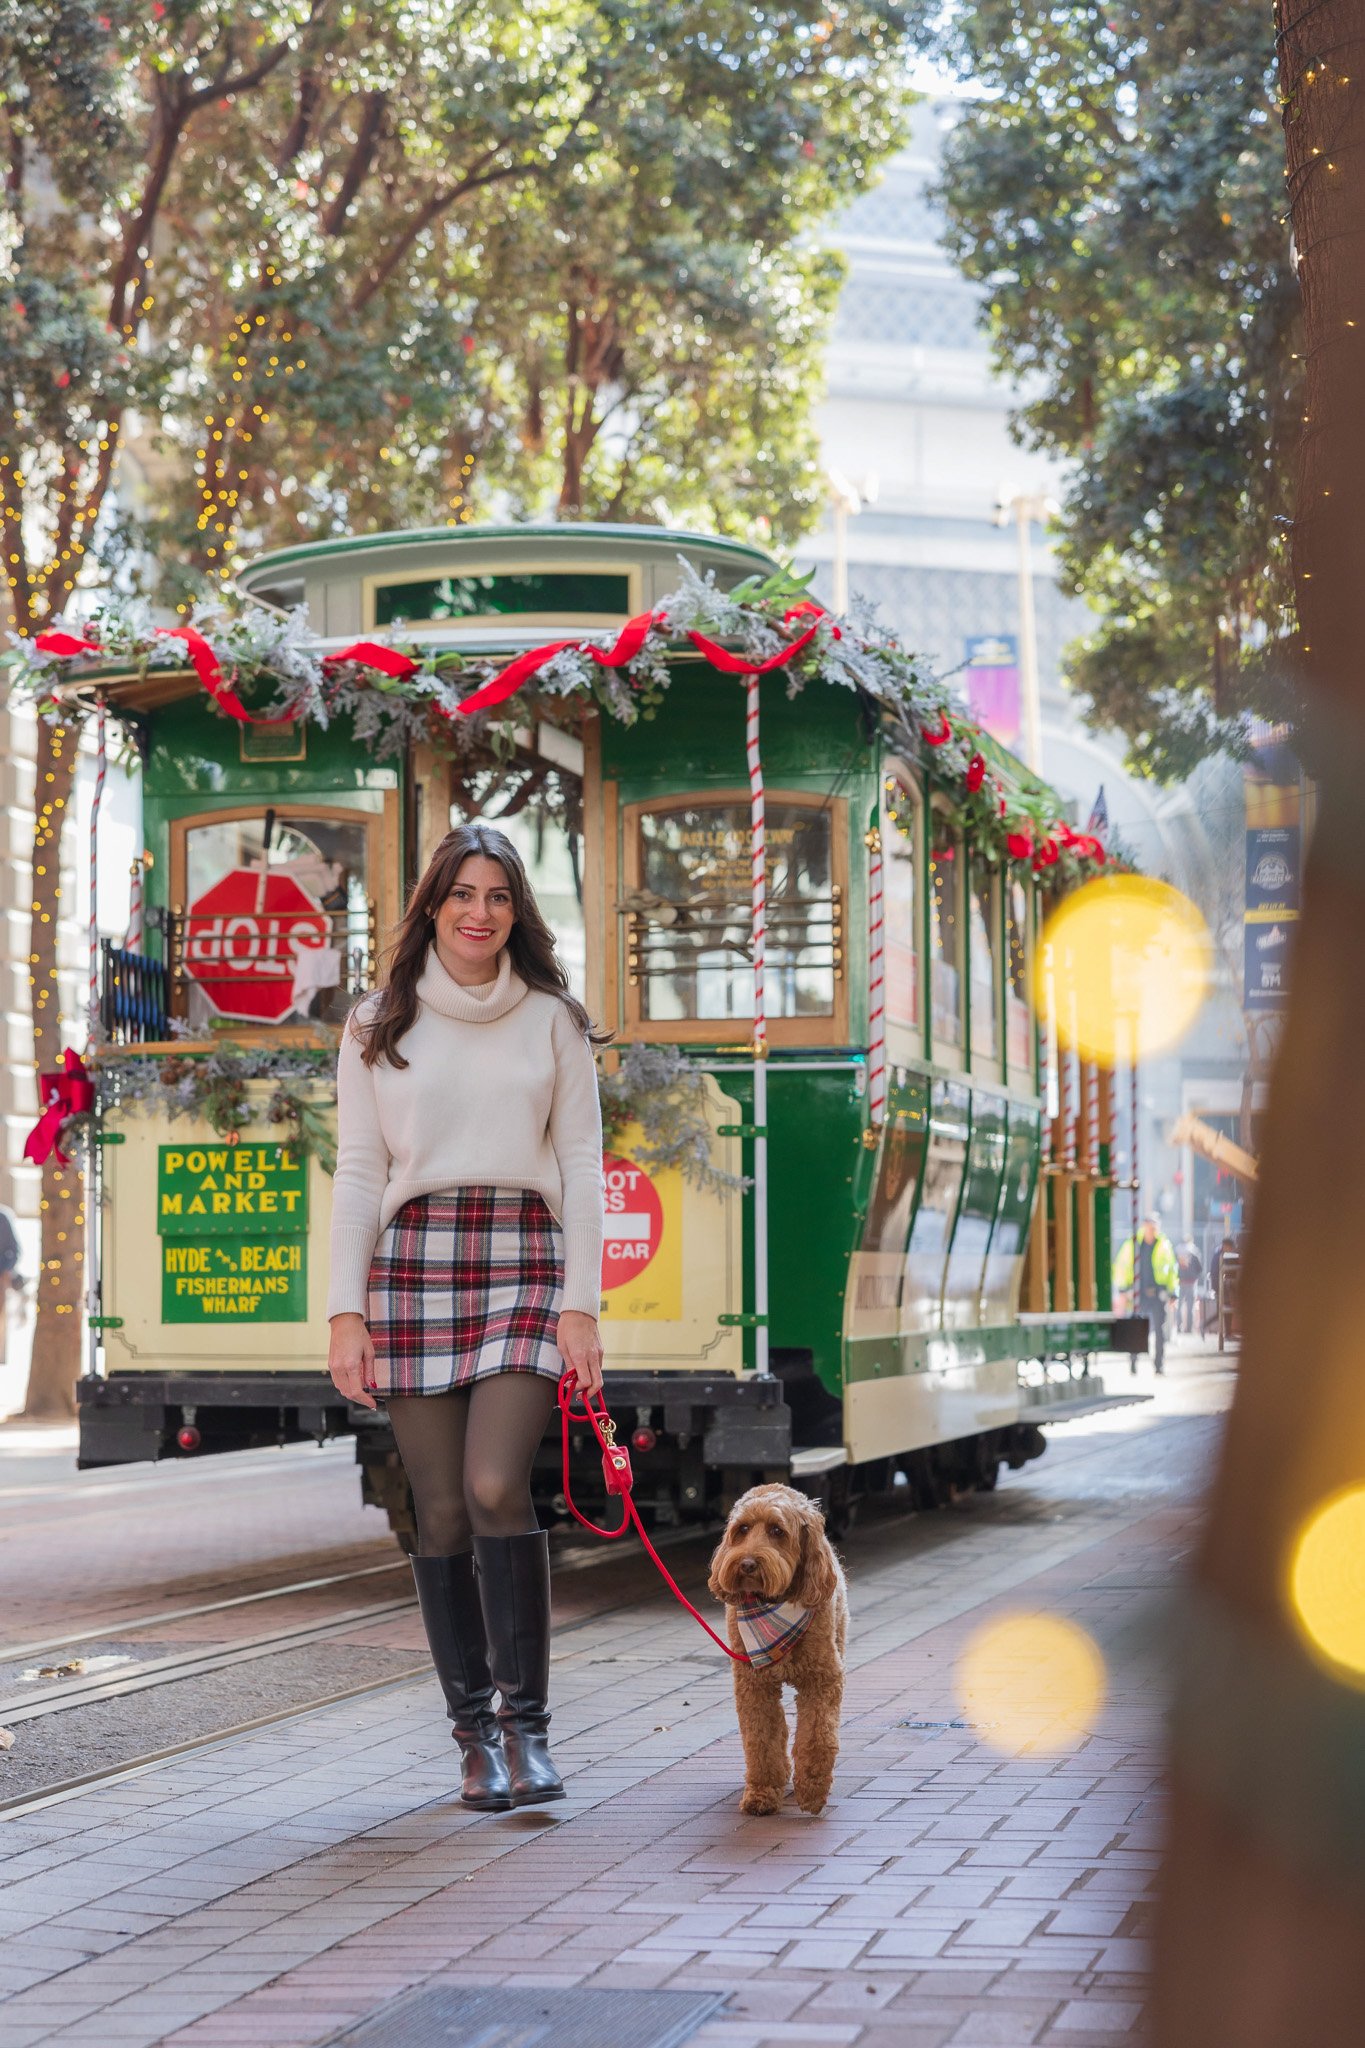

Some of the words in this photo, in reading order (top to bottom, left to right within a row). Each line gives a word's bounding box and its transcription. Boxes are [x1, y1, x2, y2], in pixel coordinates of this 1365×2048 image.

[165, 1150, 299, 1174] POWELL
[200, 1172, 266, 1191] AND
[603, 1170, 641, 1191] OT
[161, 1191, 302, 1215] MARKET
[165, 1247, 212, 1273] HYDE
[240, 1245, 302, 1272] BEACH
[607, 1242, 650, 1260] CAR
[175, 1276, 289, 1296] FISHERMANS
[202, 1296, 261, 1313] WHARF
